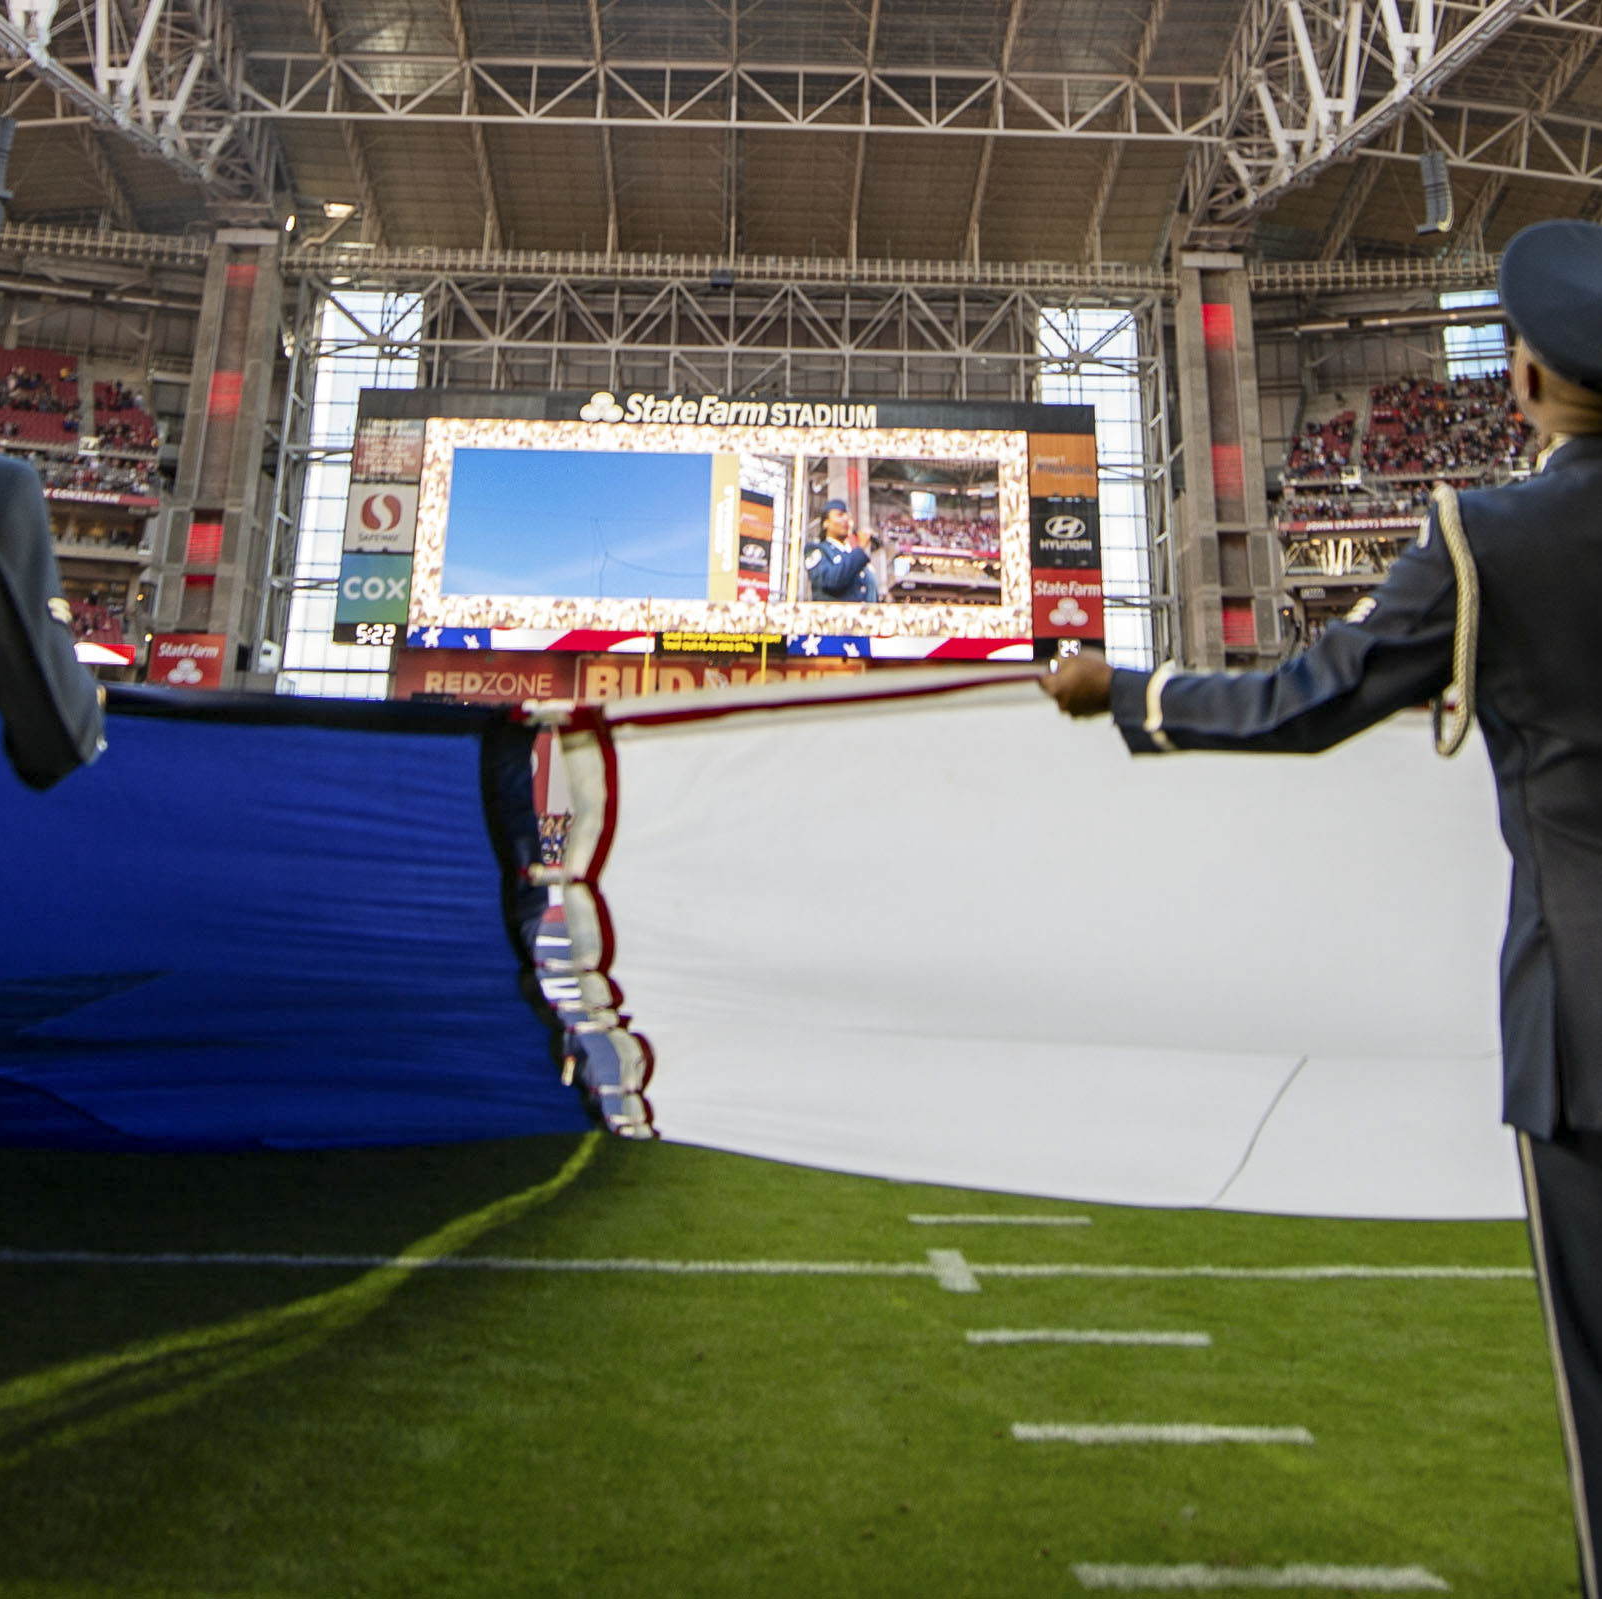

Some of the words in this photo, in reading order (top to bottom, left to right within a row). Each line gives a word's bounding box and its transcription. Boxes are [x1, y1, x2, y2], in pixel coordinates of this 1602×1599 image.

[771, 402, 878, 428] STADIUM
[1306, 521, 1334, 531] JOHN
[1040, 539, 1092, 551] HYUNDAI
[343, 576, 408, 600] COX
[355, 623, 396, 646] 5:22
[424, 671, 552, 697] REDZONE
